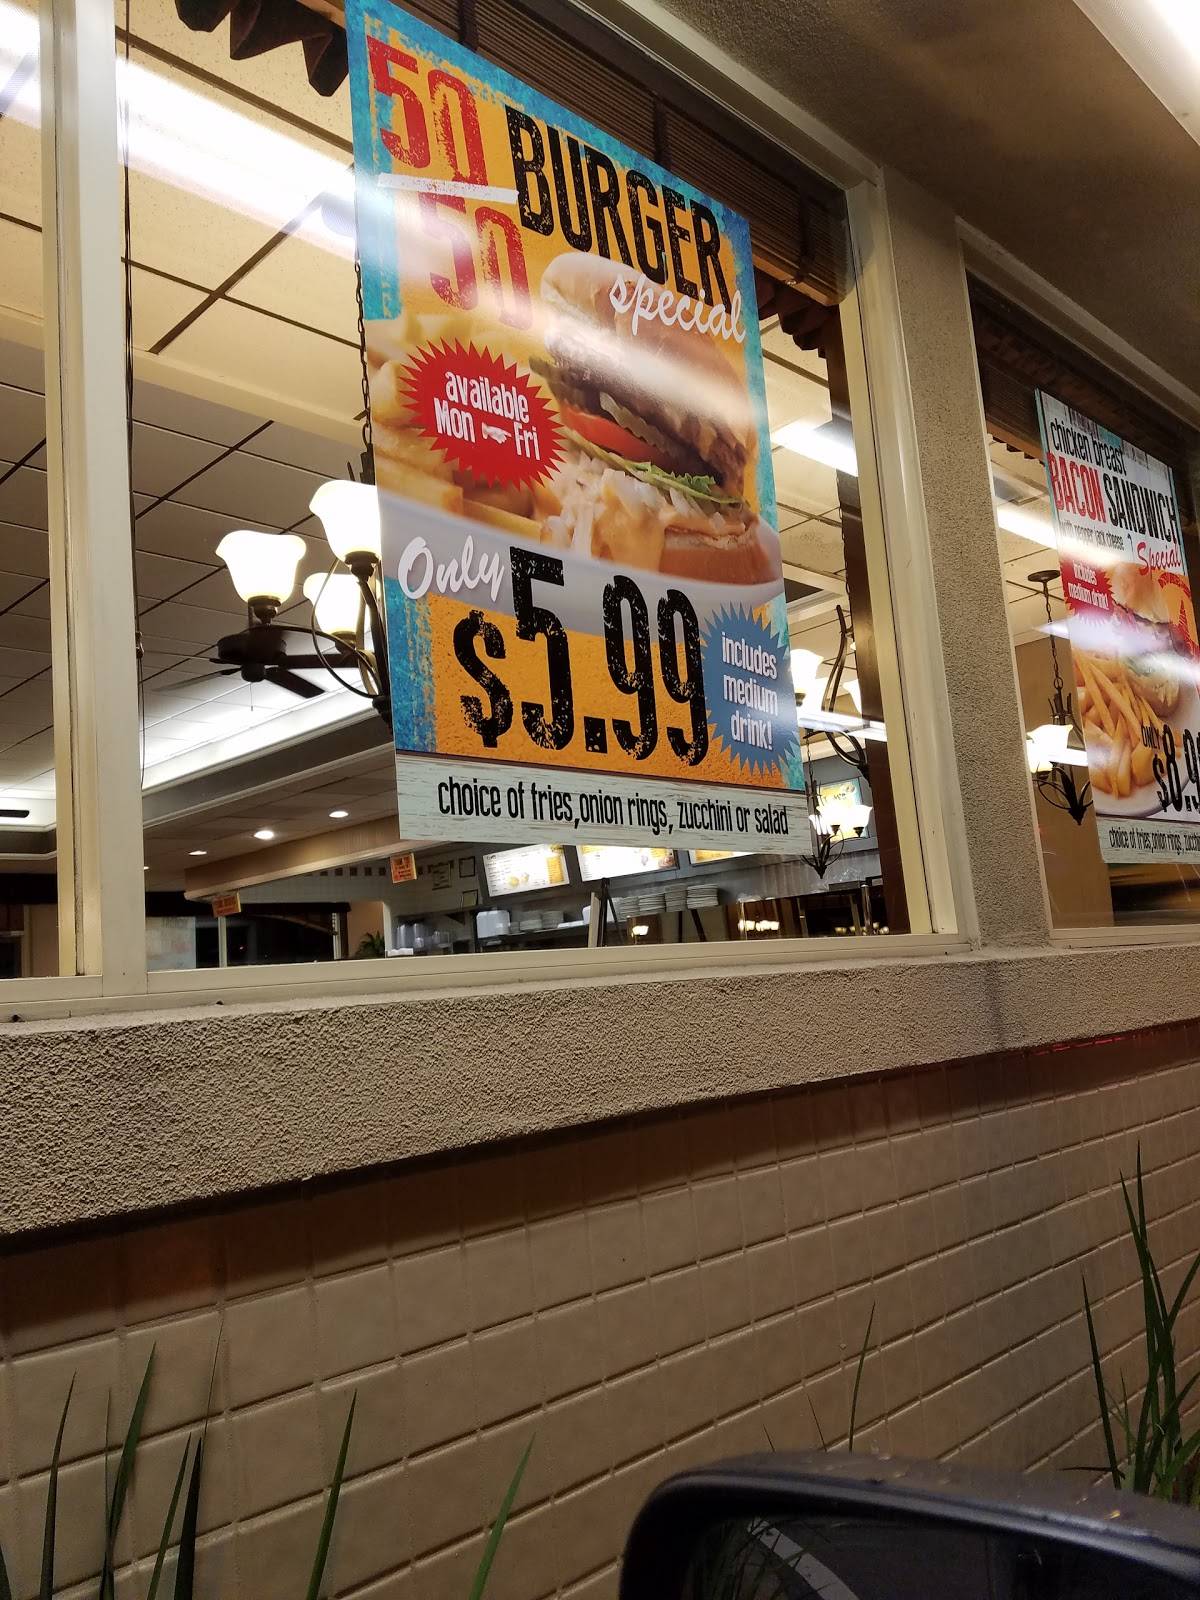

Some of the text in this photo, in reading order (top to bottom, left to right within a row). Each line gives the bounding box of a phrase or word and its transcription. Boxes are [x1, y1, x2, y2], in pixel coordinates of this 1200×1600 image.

[366, 36, 487, 188] 50
[505, 105, 732, 315] BURGER
[418, 190, 534, 332] 50
[609, 272, 746, 344] special
[445, 370, 530, 423] available
[433, 397, 540, 461] Mon Fri
[1050, 418, 1127, 476] chicken breast
[1047, 452, 1181, 546] BACON SANDWICH
[398, 535, 505, 602] Only
[1072, 560, 1098, 585] includes
[1136, 541, 1182, 577] Special
[1068, 583, 1091, 604] medium
[453, 546, 710, 767] $5.99
[721, 631, 777, 680] includes
[723, 673, 779, 718] medium
[730, 711, 773, 751] drink!
[1140, 724, 1161, 750] ONLY
[438, 776, 501, 817] choice
[507, 781, 525, 819] of
[627, 793, 674, 836] rings,
[677, 799, 733, 832] zucchini
[736, 805, 751, 833] or
[754, 803, 789, 835] salad
